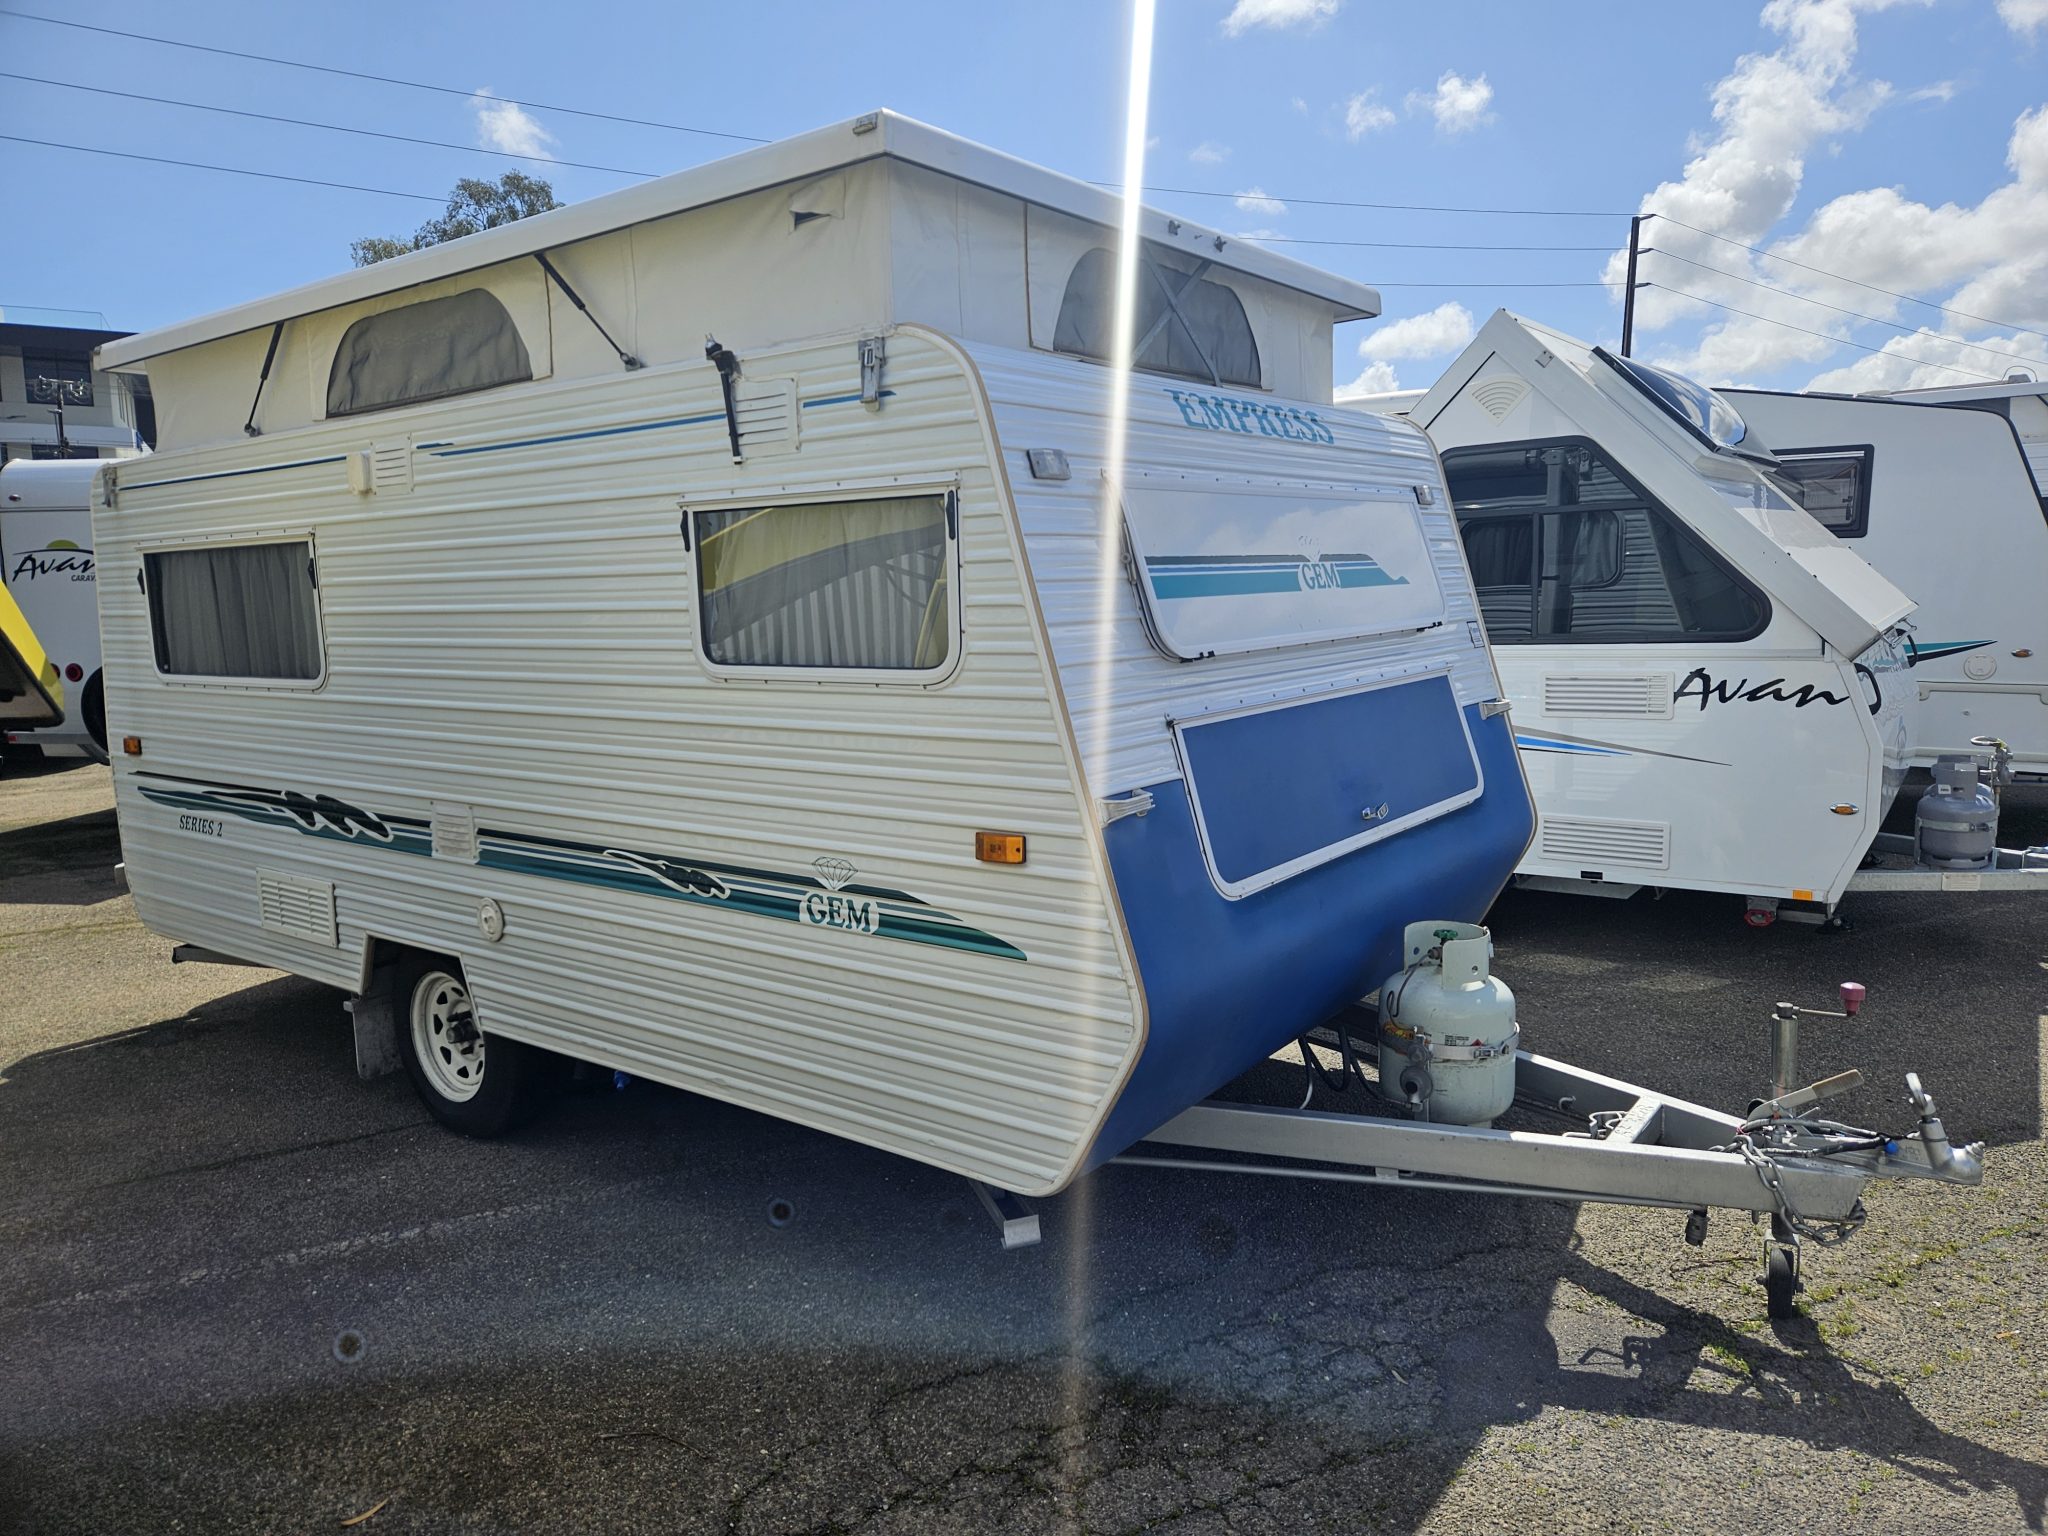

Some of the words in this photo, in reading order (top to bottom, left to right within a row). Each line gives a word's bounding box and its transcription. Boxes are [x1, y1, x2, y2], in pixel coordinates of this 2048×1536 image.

[1163, 388, 1335, 445] EMPRESS
[71, 574, 97, 582] CARAV
[1301, 563, 1340, 590] GEM
[1673, 667, 1850, 711] Avan
[179, 814, 214, 836] SERIES
[217, 821, 223, 837] 2
[806, 893, 871, 932] GEM
